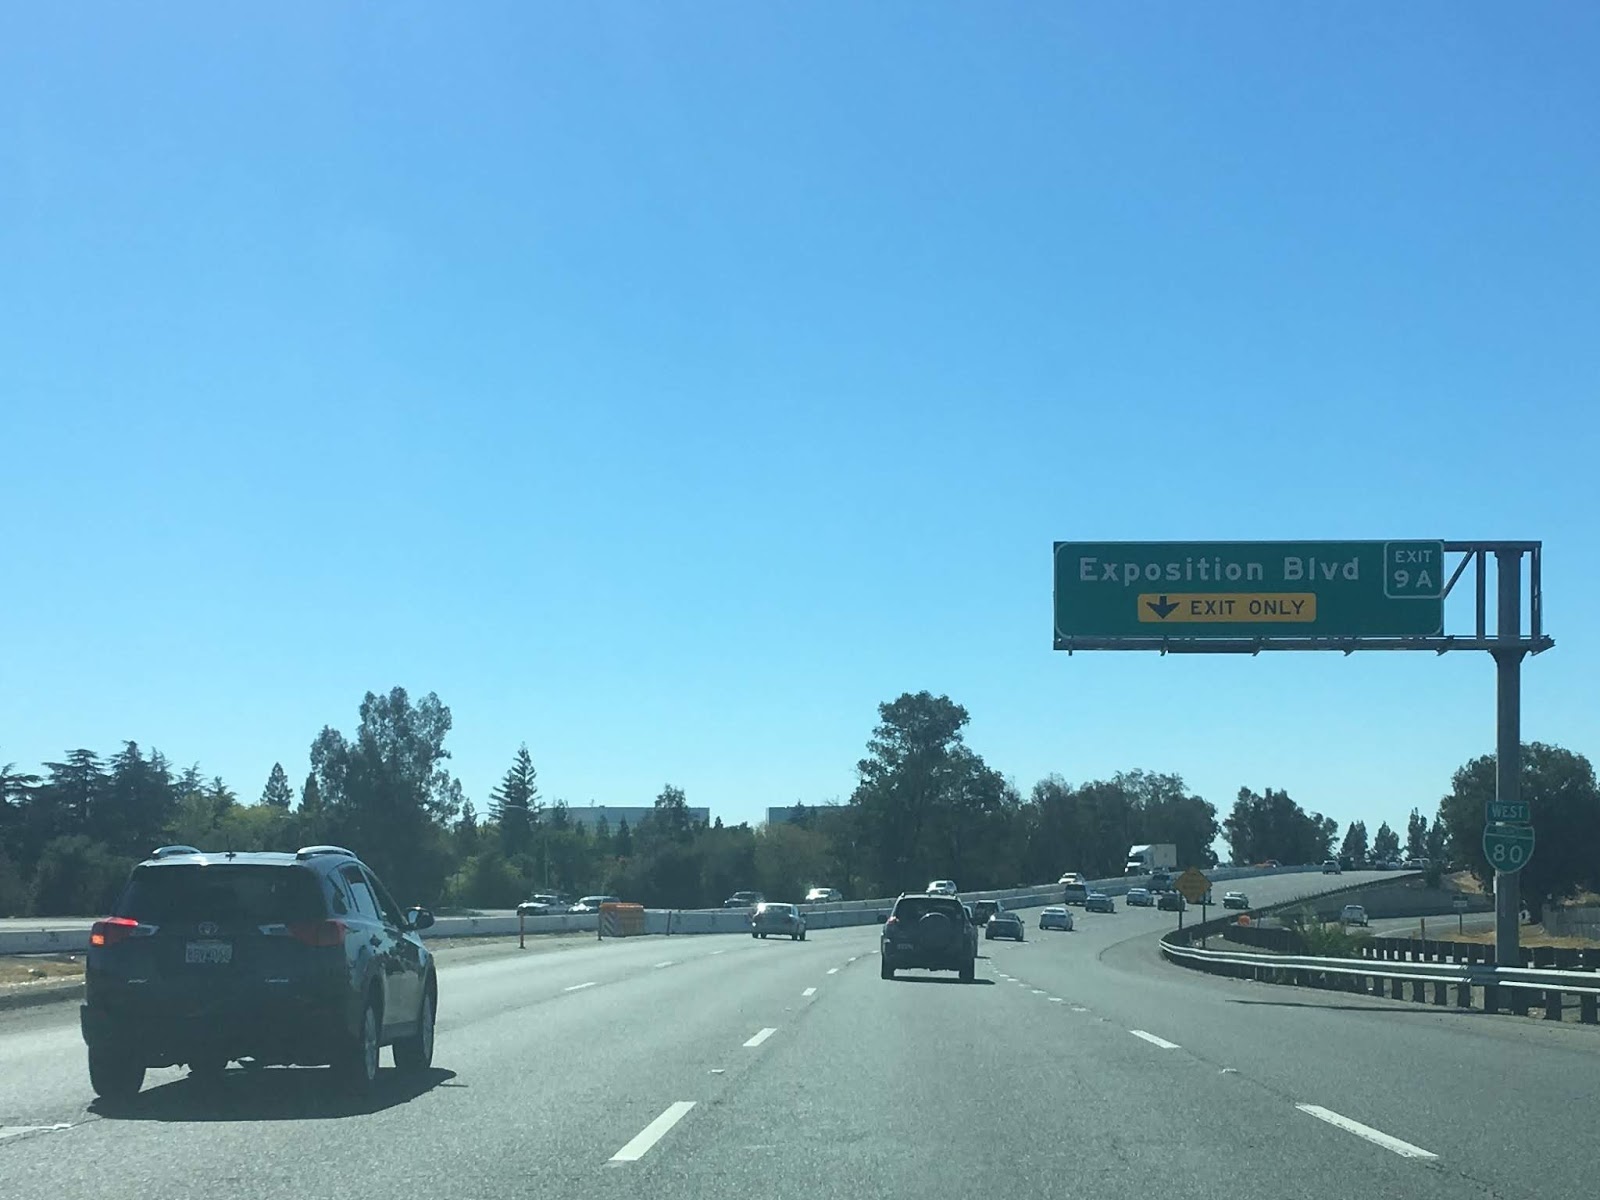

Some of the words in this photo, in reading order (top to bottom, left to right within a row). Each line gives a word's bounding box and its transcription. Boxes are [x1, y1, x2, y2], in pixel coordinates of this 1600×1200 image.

[1394, 550, 1433, 563] EXIT
[1079, 557, 1263, 587] Exposition
[1284, 556, 1359, 580] Blvd
[1190, 600, 1236, 615] EXIT
[1248, 599, 1305, 615] ONLY
[1492, 805, 1524, 818] WEST
[1493, 844, 1523, 863] 80
